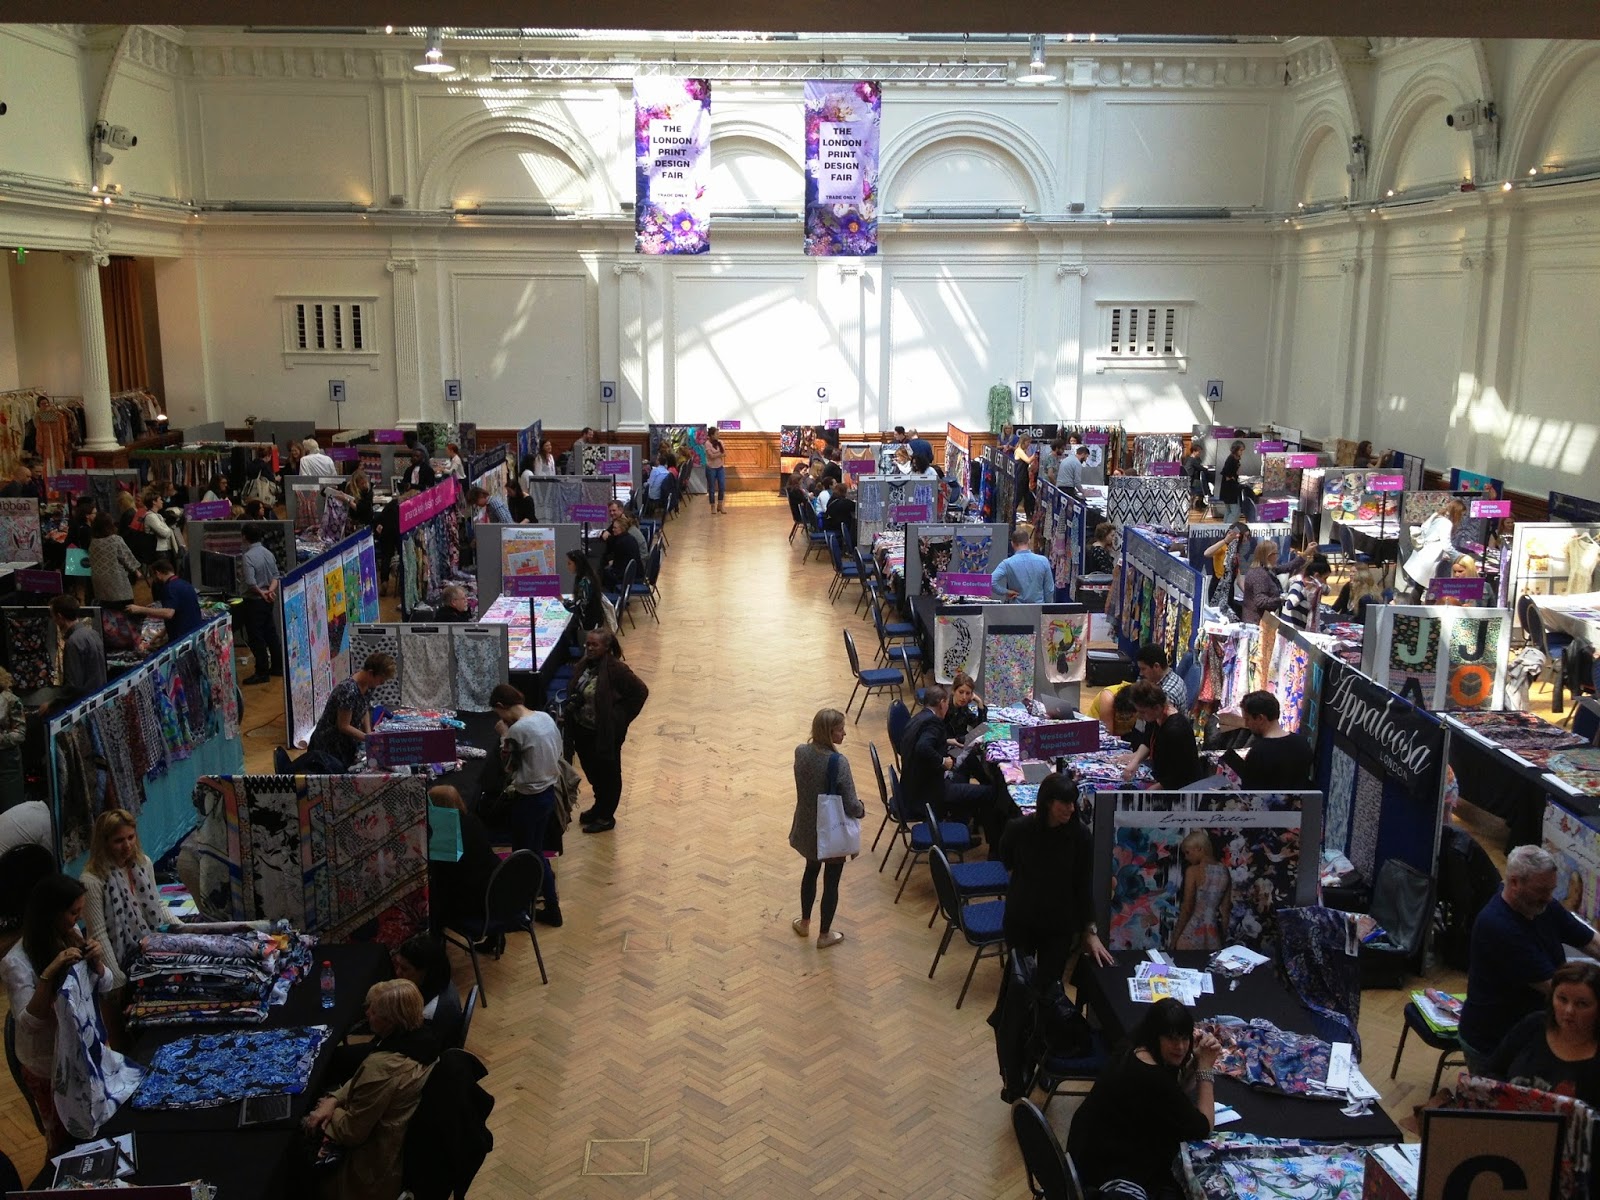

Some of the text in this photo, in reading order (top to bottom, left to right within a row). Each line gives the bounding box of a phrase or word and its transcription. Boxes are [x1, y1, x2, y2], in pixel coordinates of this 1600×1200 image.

[334, 386, 341, 396] F
[449, 385, 458, 396] E
[604, 386, 612, 397] D
[817, 387, 826, 398] C
[1020, 386, 1028, 397] B
[1210, 386, 1219, 396] A
[1016, 426, 1043, 438] cake
[1191, 529, 1224, 538] WHISTON
[1397, 617, 1431, 664] J
[1458, 619, 1489, 660] J
[1325, 660, 1431, 774] Appaloosa
[1040, 732, 1074, 740] Westcott
[1040, 741, 1080, 750] Appaloosa
[1380, 750, 1408, 781] LONDON
